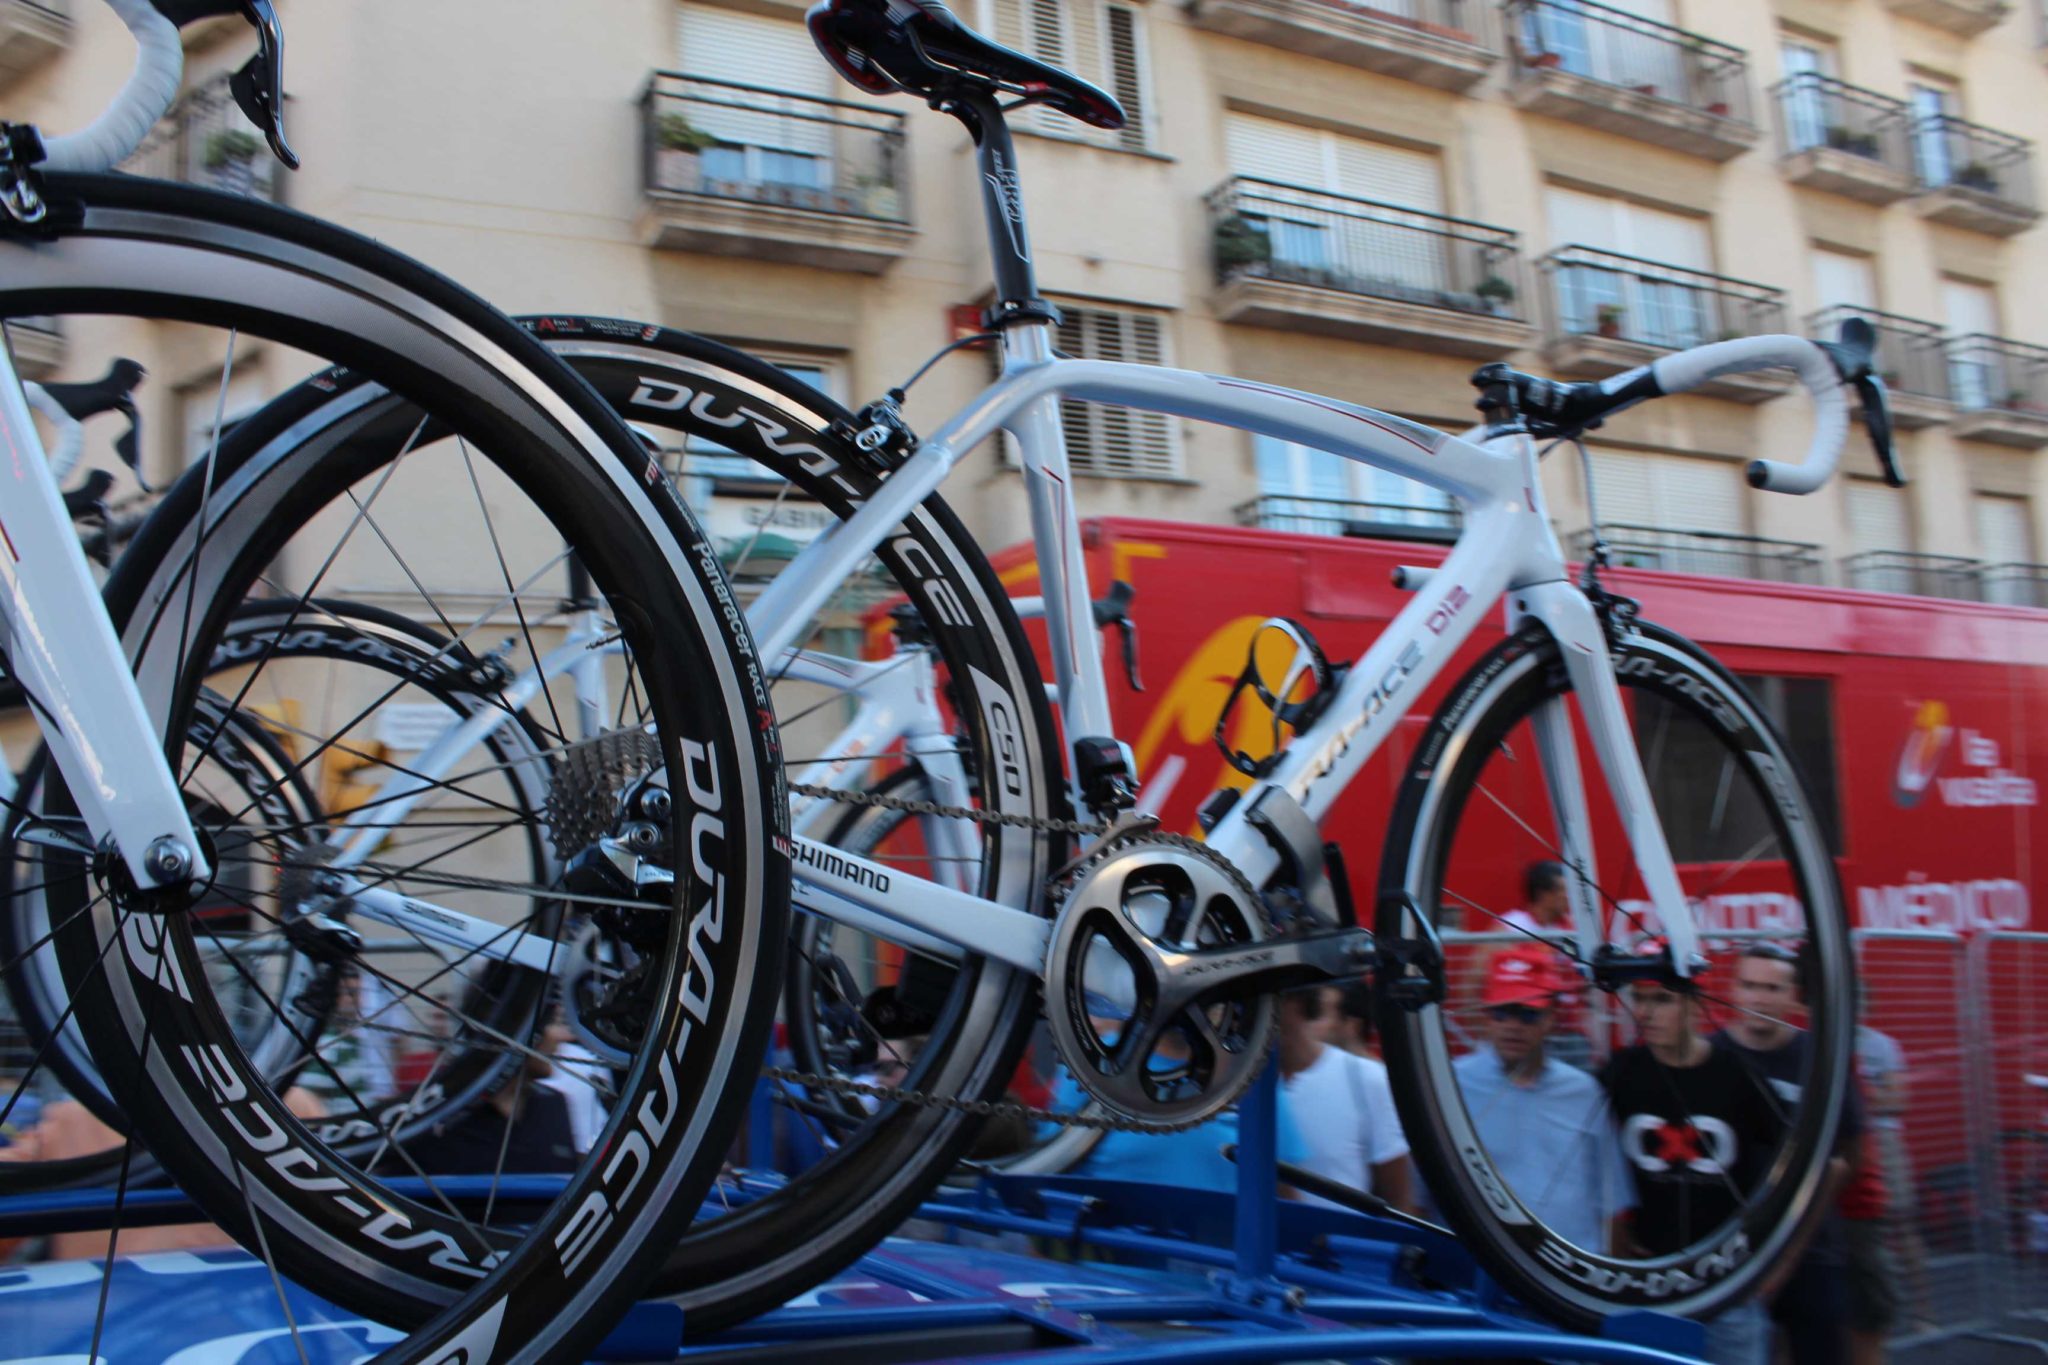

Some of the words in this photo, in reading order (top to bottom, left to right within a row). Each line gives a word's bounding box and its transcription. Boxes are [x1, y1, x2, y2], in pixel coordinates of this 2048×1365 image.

[692, 539, 755, 660] Panaracer
[747, 662, 768, 706] RACE
[990, 701, 1022, 797] C50
[790, 841, 890, 894] SHIMANO
[555, 737, 726, 1278] DURA-ACE
[179, 1043, 512, 1279] RA-ACE
